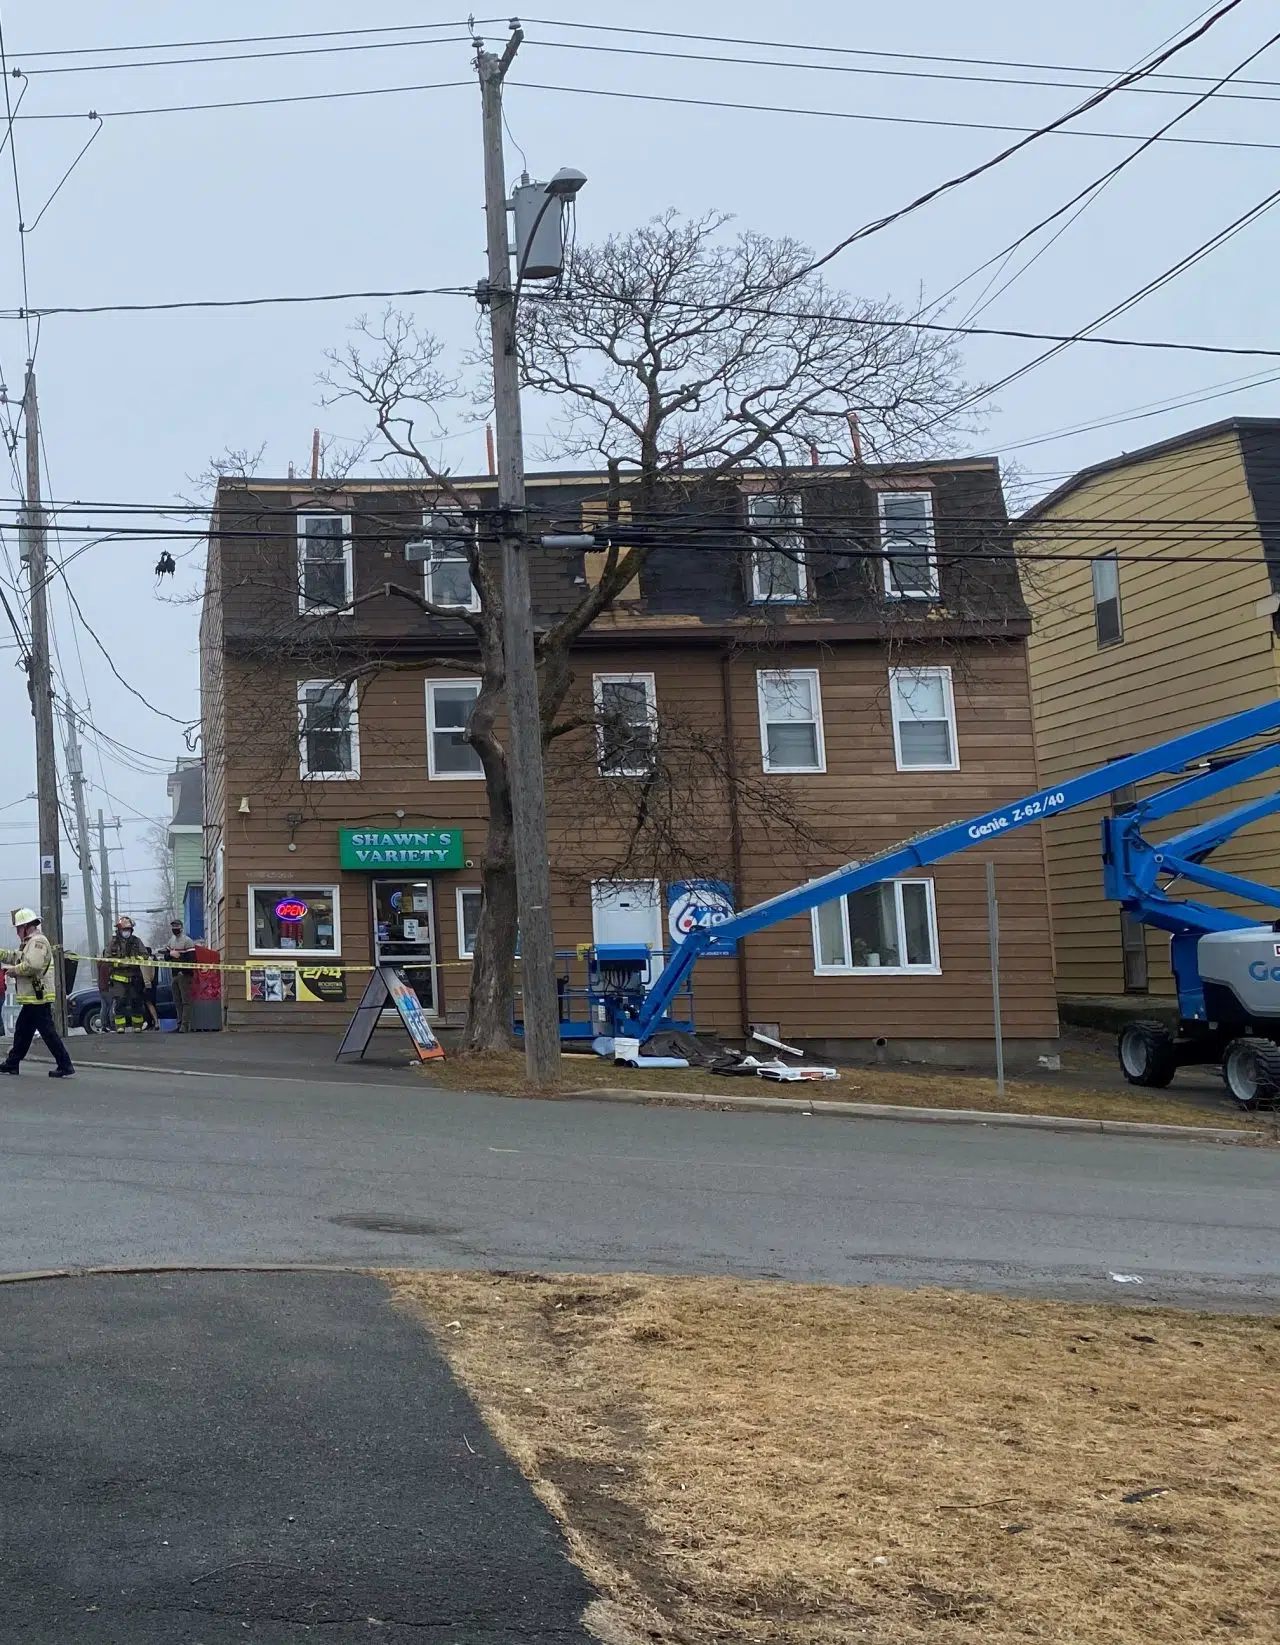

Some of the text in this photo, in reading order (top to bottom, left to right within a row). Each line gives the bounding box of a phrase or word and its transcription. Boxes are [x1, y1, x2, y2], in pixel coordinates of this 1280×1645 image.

[968, 792, 1065, 838] Genie Z-62/40
[355, 849, 449, 862] VARIETY
[277, 904, 305, 916] OPEN
